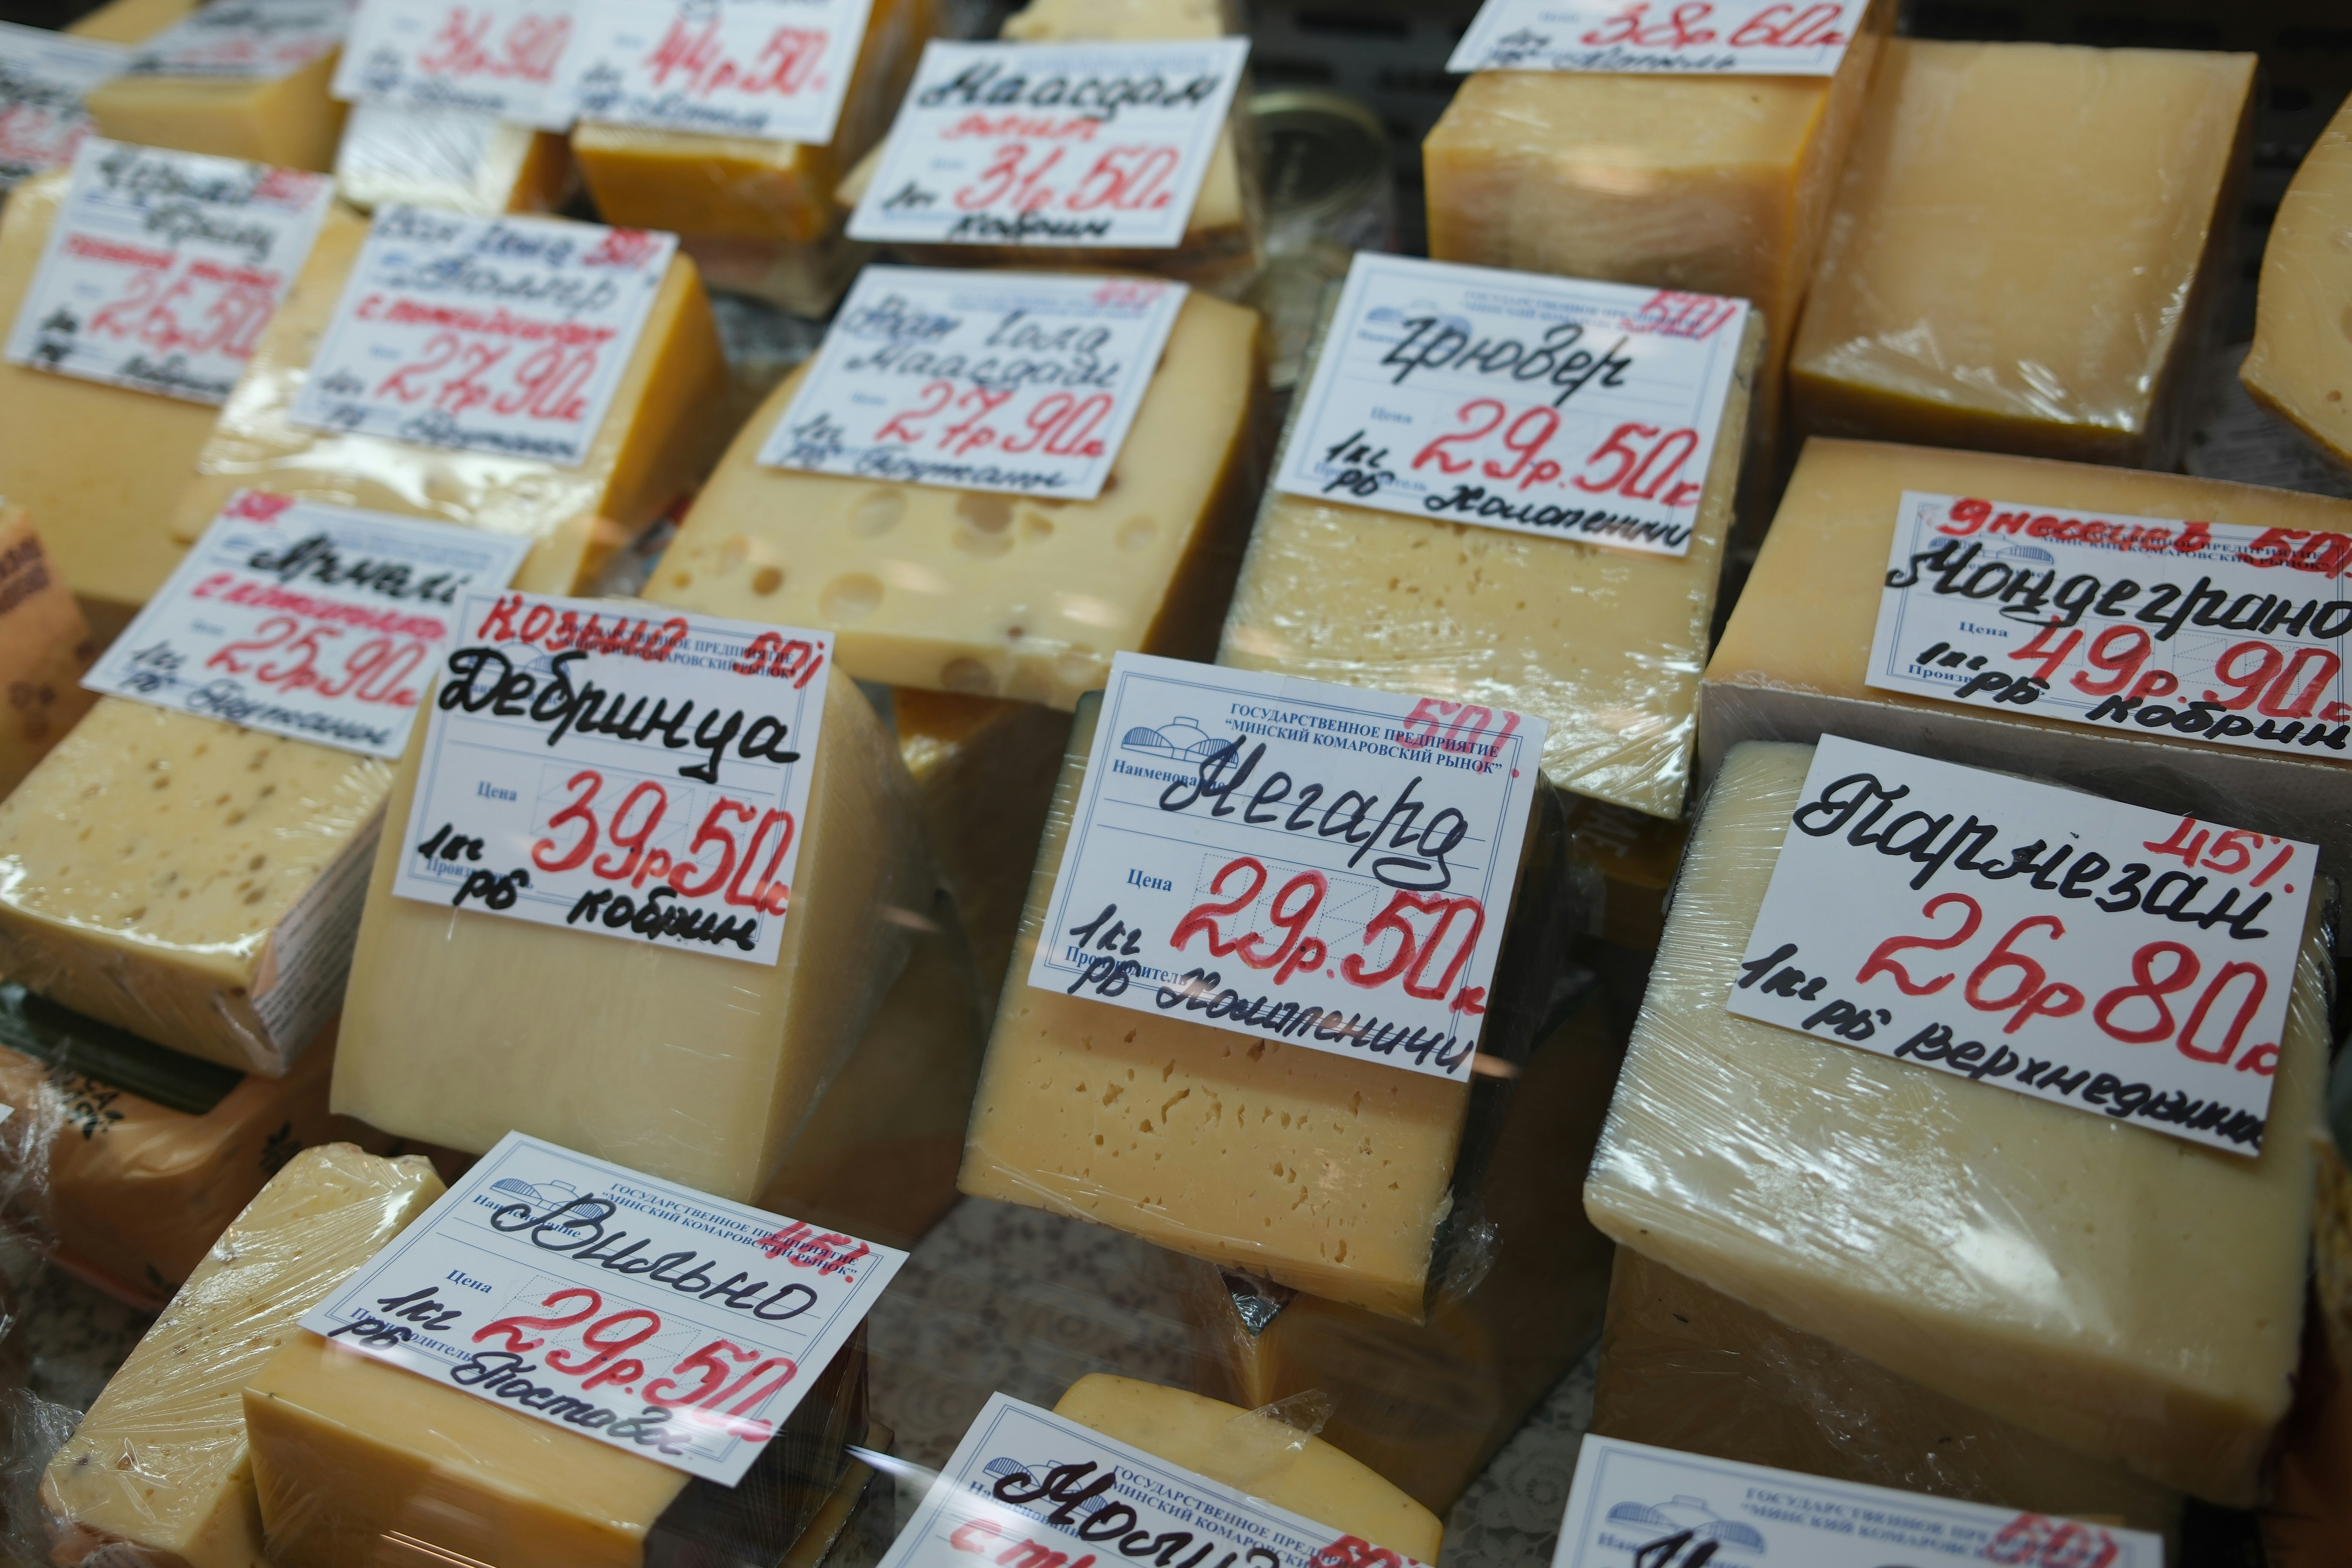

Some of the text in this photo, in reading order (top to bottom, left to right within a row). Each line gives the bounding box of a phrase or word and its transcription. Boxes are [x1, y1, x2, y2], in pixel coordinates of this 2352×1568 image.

[1958, 621, 2009, 639] Цена
[1907, 664, 2046, 696] Произвь
[438, 646, 800, 784] Дебринца
[1231, 702, 1500, 759] ГОСУДАРСТВЕННОЕ ПРЕДПРИЯТИЕ
[1312, 732, 1432, 765] КОМАРОВСКИЙ
[477, 779, 518, 803] Цена
[1112, 758, 1228, 790] Наименоваие
[1792, 772, 2275, 940] Пармезан
[2142, 817, 2294, 894] 45%
[1127, 868, 1173, 893] Цена
[1069, 903, 1142, 956] 1кг
[1063, 945, 1189, 987] Проиводитель
[1737, 943, 1828, 1001] 1кг
[609, 1182, 860, 1267] ГОСУДАРСТВЕННОЕ ПРЕДПРИЯТИЕ
[680, 1216, 792, 1259] КОМАРОВСКИЙ
[490, 1191, 818, 1320] Вильно
[444, 1268, 493, 1294] Цена
[377, 1286, 462, 1331] 1кг
[1112, 1464, 1271, 1538] ГОСУДАРСТВЕННОЕ
